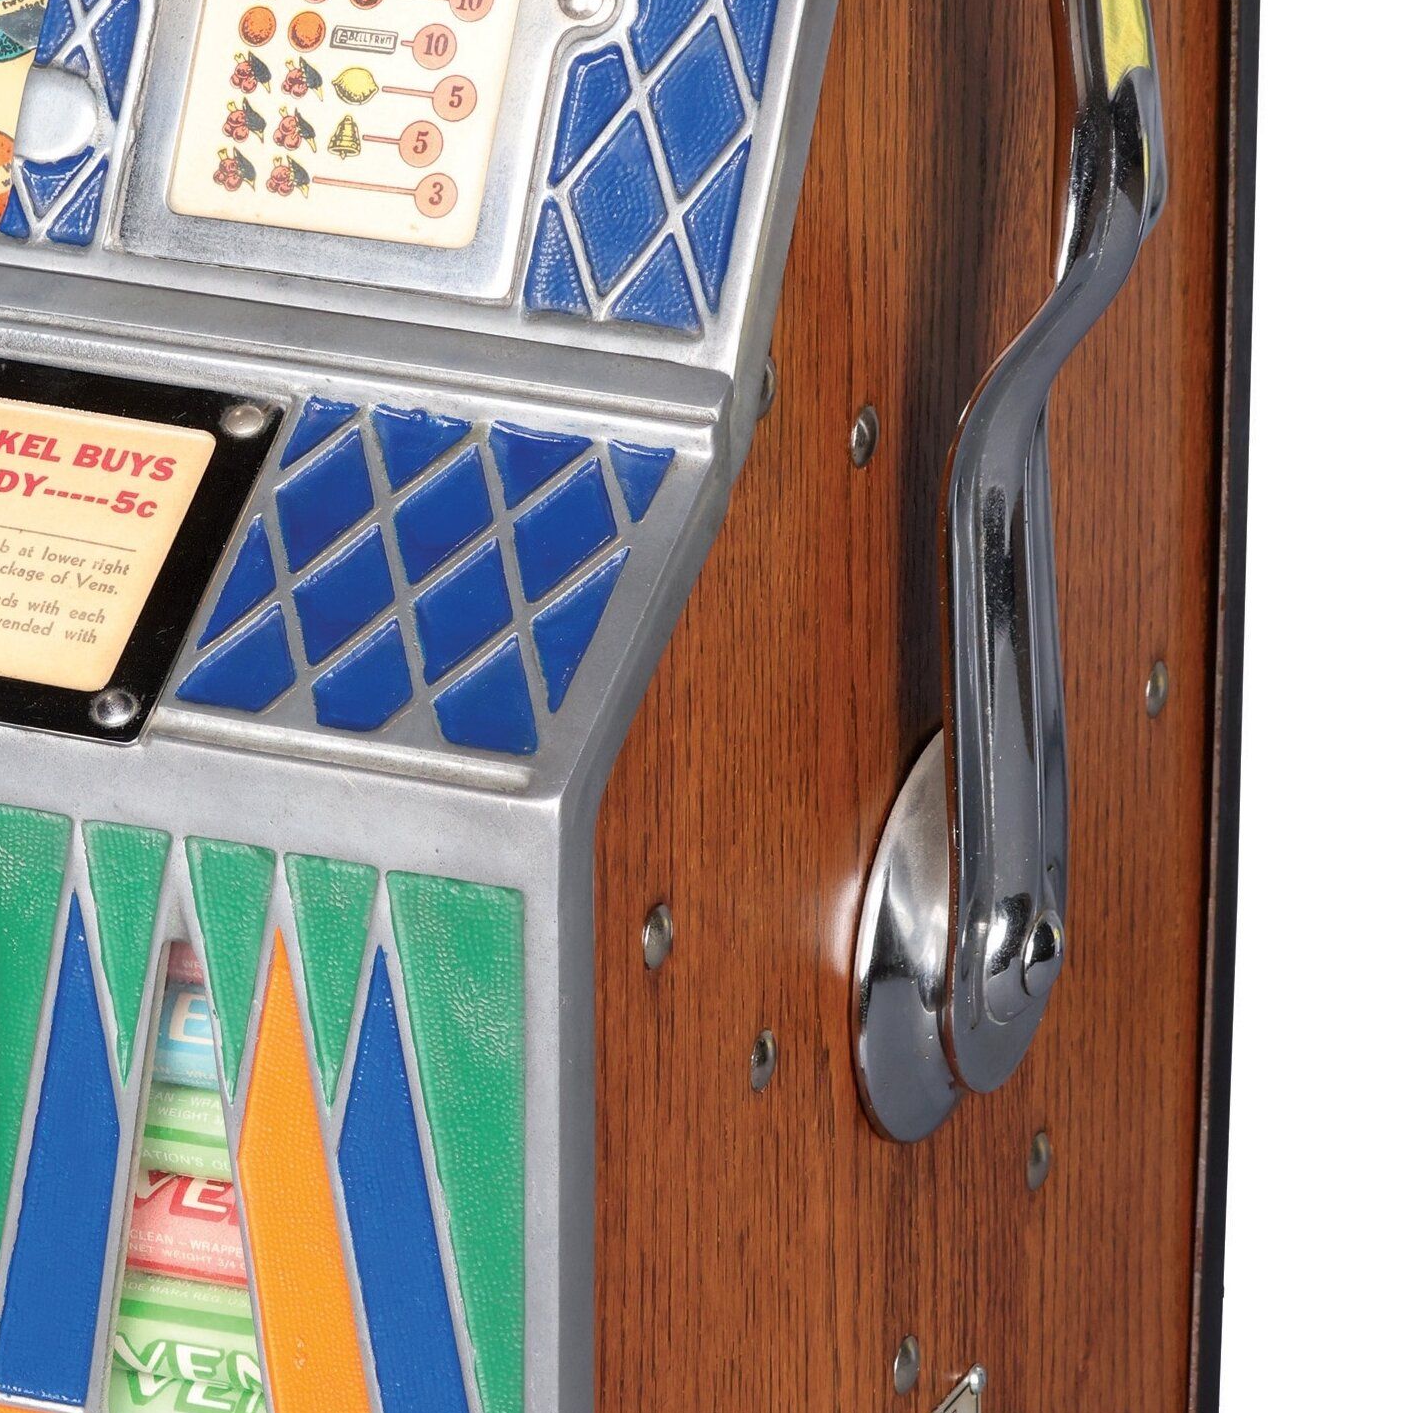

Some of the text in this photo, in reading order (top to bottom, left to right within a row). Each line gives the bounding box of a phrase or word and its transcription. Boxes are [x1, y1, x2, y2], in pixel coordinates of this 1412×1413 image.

[423, 32, 449, 57] 10
[449, 86, 464, 108] 5
[413, 131, 429, 154] 5
[429, 182, 444, 205] 3
[72, 444, 176, 482] BUYS
[19, 546, 34, 558] at
[42, 546, 86, 567] lower
[92, 561, 129, 576] right
[51, 572, 69, 584] of
[77, 573, 118, 595] Vens.
[28, 600, 60, 616] with
[69, 609, 106, 625] each
[65, 629, 97, 644] with
[130, 1229, 174, 1245] CLEAN
